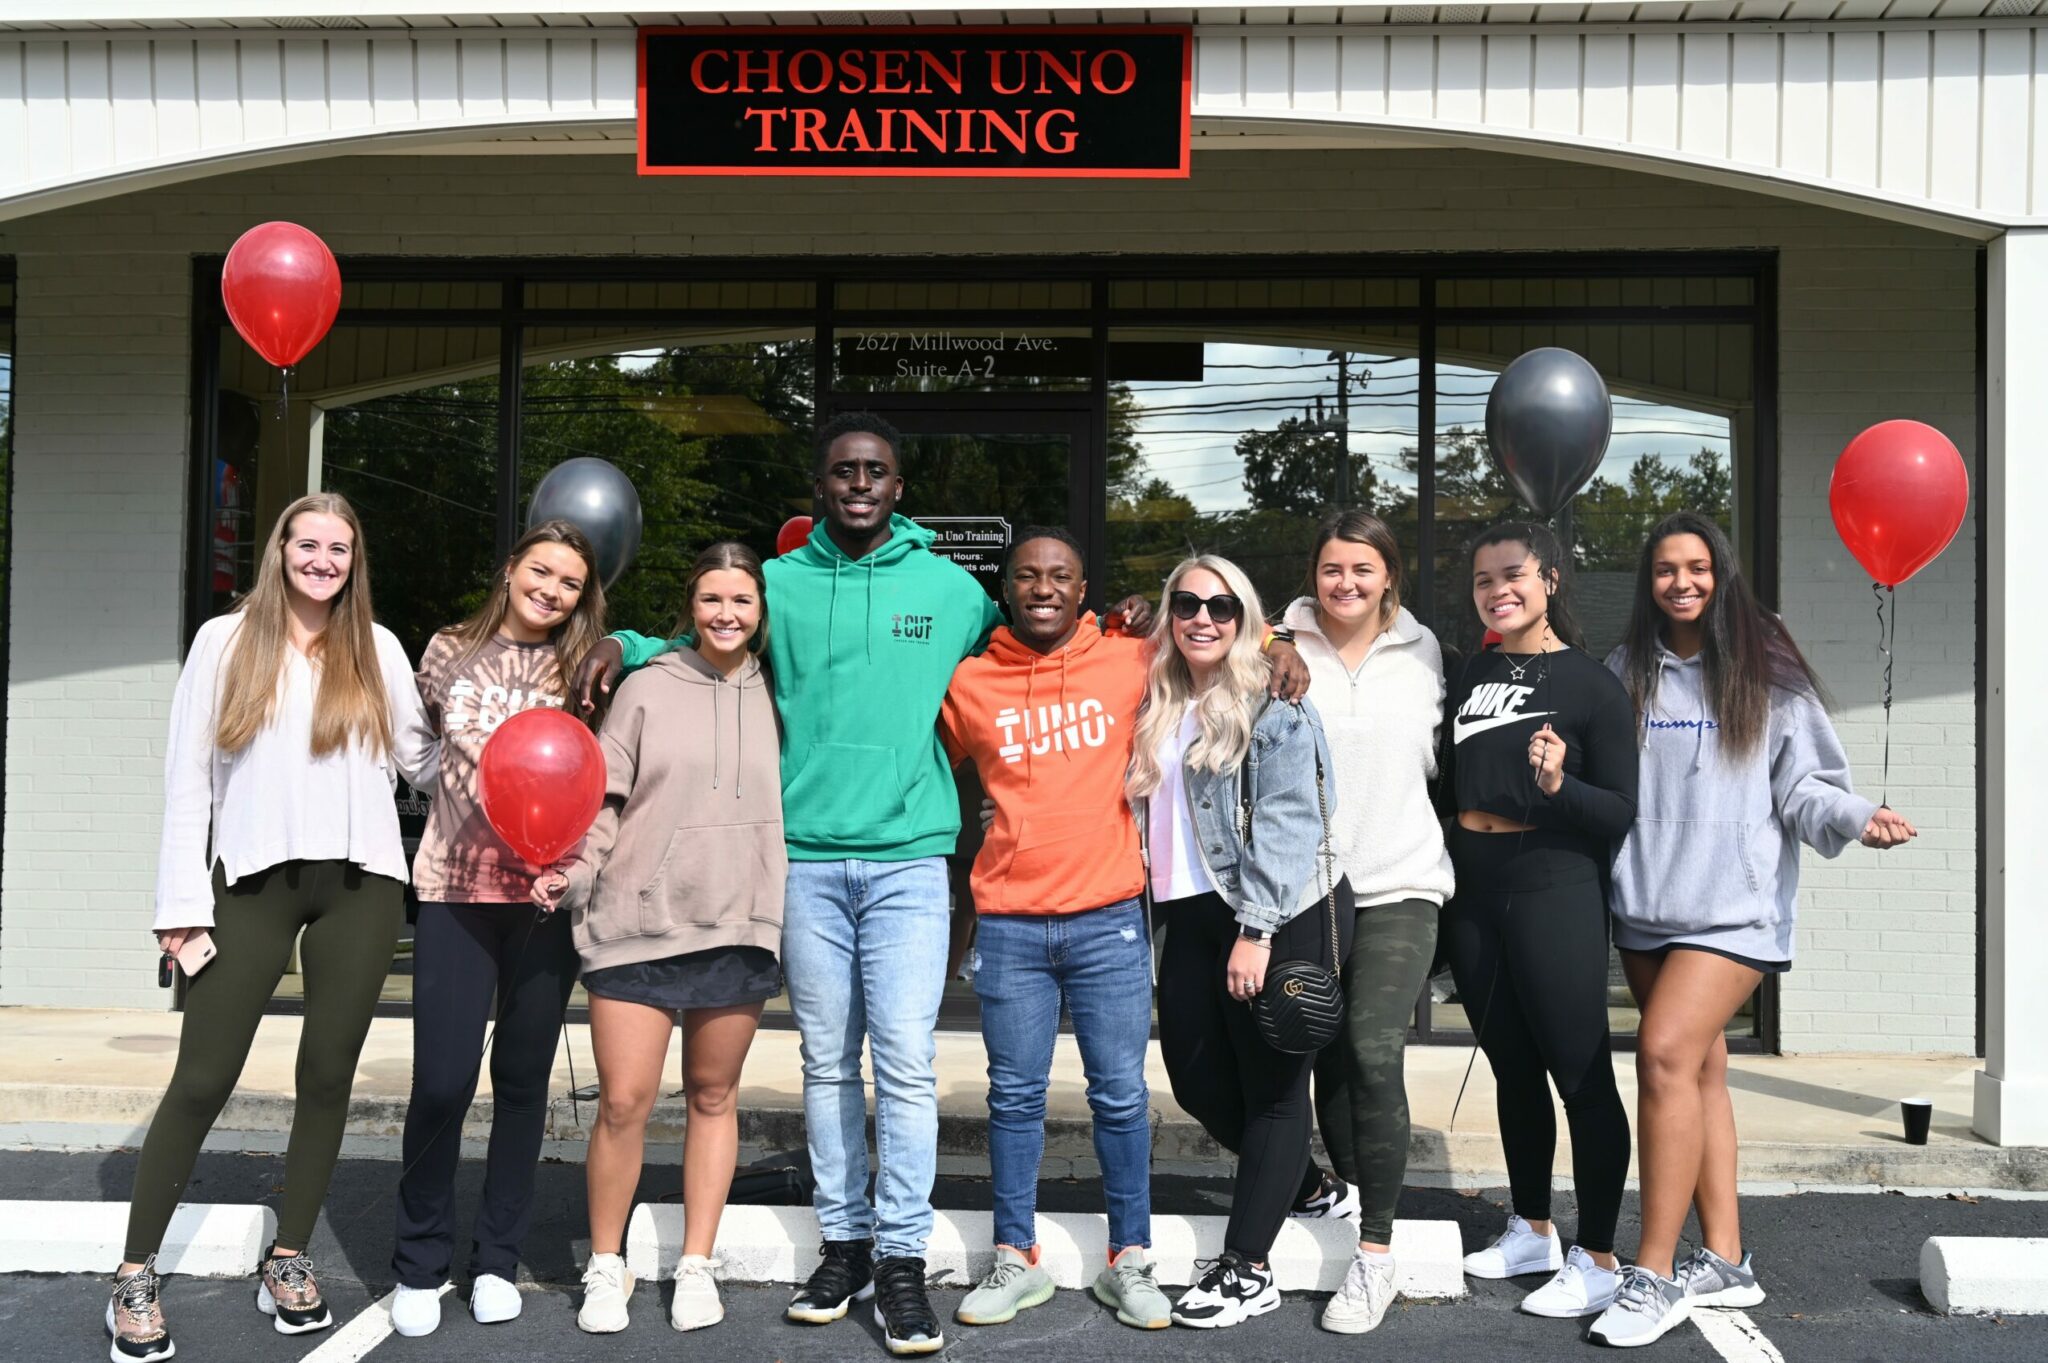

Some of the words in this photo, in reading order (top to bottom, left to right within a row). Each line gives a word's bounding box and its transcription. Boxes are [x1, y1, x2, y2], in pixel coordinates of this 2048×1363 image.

[690, 48, 966, 95] CHOSEN
[986, 48, 1138, 95] UNO
[743, 106, 1080, 154] TRAINING
[856, 332, 900, 351] 2627
[909, 331, 1004, 351] Millwood
[1014, 333, 1058, 351] Ave.
[896, 358, 948, 378] Suite
[957, 355, 995, 378] A-2
[945, 530, 964, 542] Uno
[965, 530, 1004, 544] Training
[953, 552, 984, 561] Hours:
[979, 563, 1000, 574] only
[1461, 682, 1536, 718] NIKE
